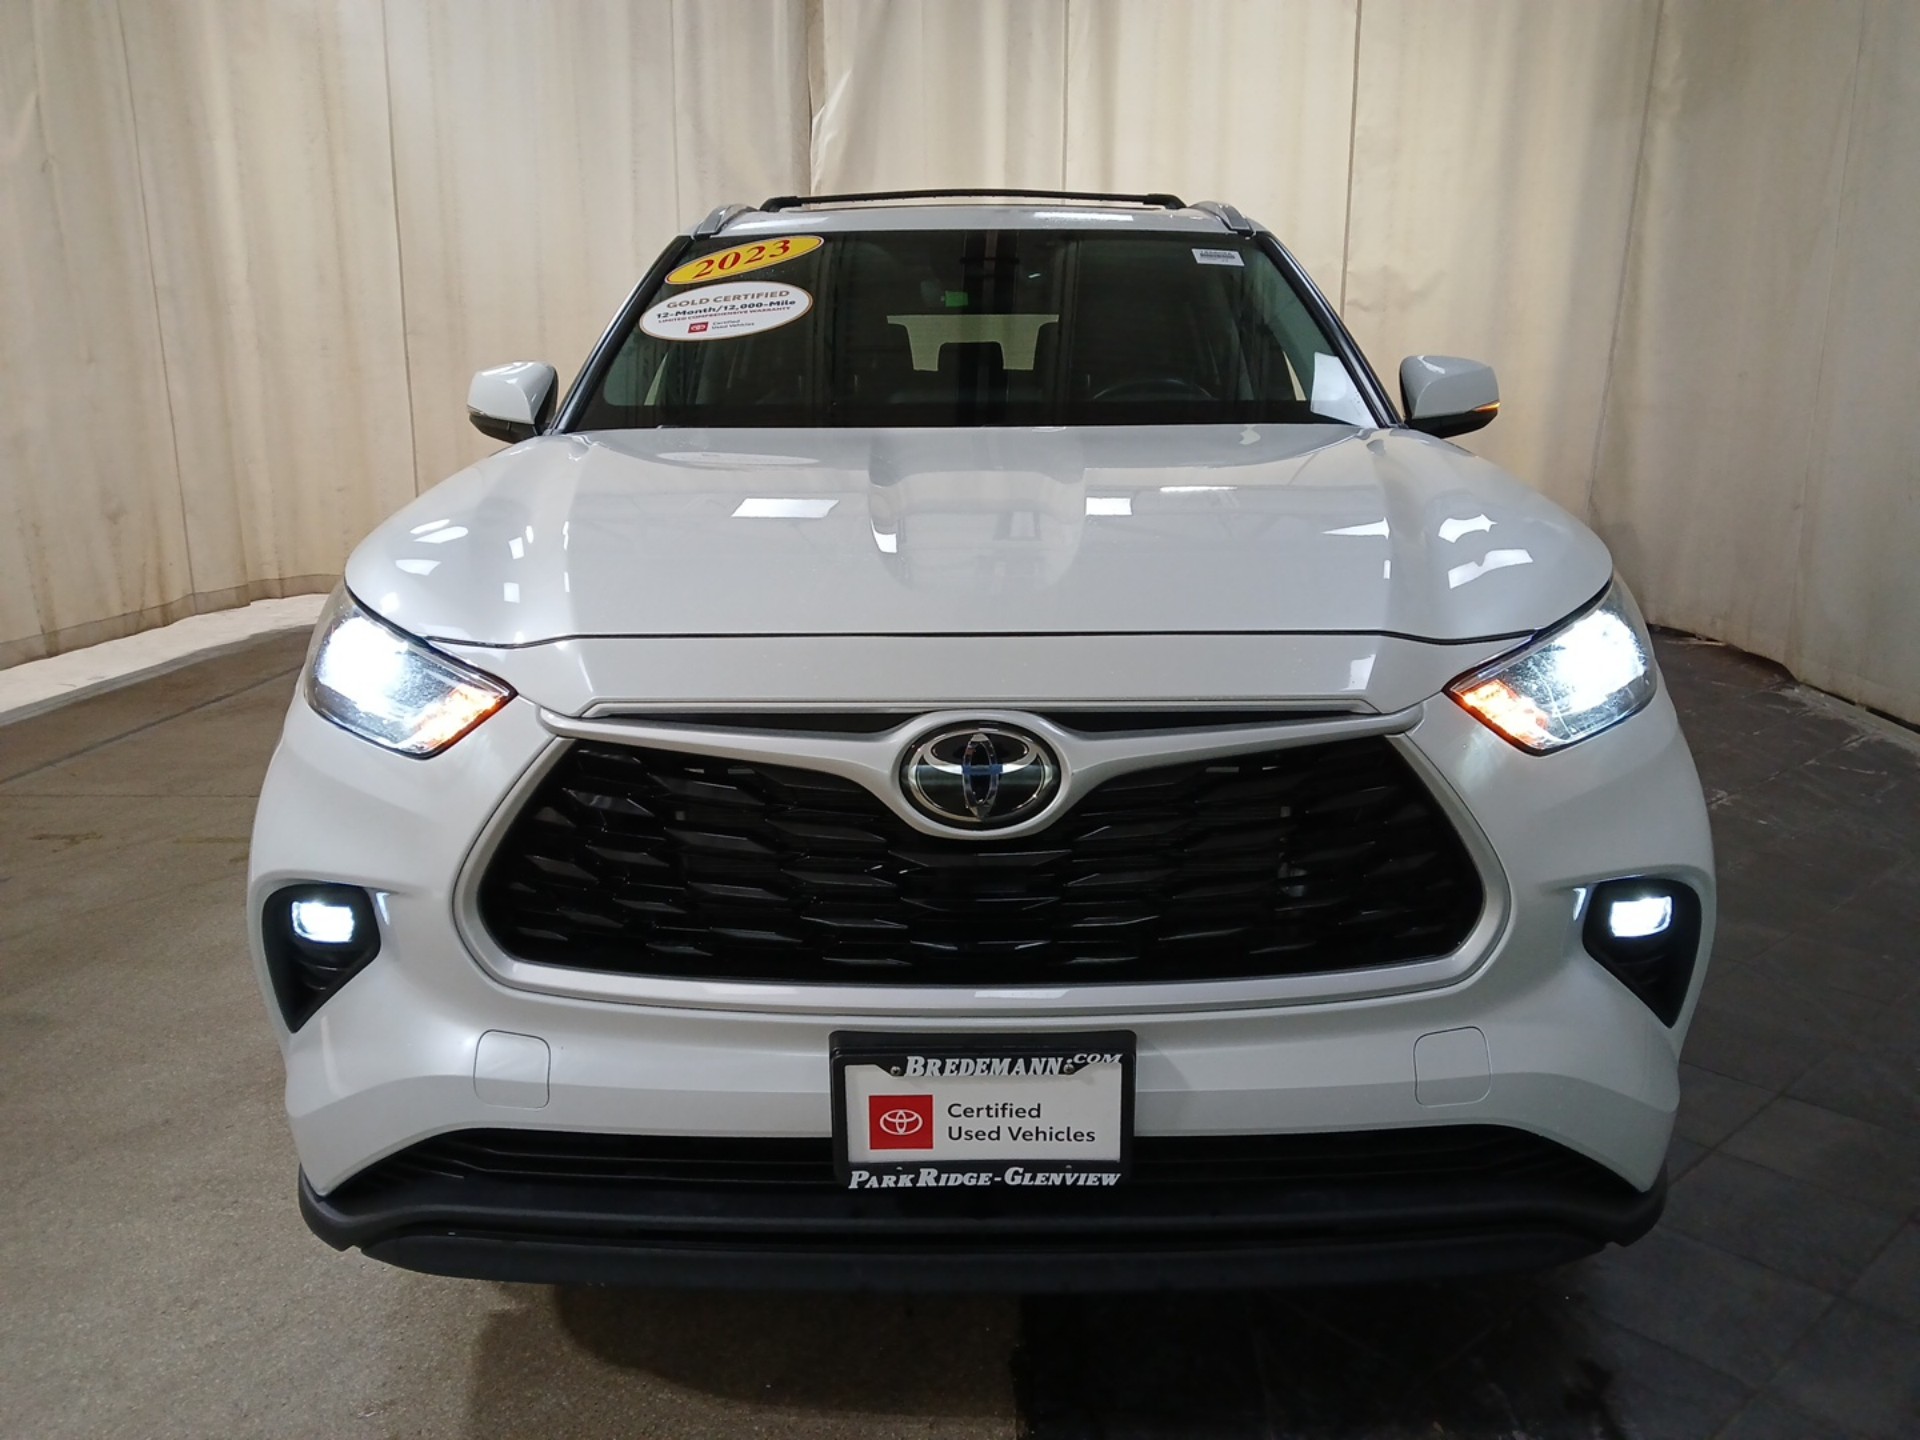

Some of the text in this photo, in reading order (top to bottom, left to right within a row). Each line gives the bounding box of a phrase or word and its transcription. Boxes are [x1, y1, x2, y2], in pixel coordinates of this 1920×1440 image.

[691, 239, 791, 279] 2023
[656, 299, 796, 319] 12-Month/12,000-Mile
[667, 290, 790, 309] GOLD CERTIFIED
[947, 1103, 1041, 1119] Certified
[947, 1126, 1096, 1143] Used Vehicles
[848, 1170, 916, 1189] PARK
